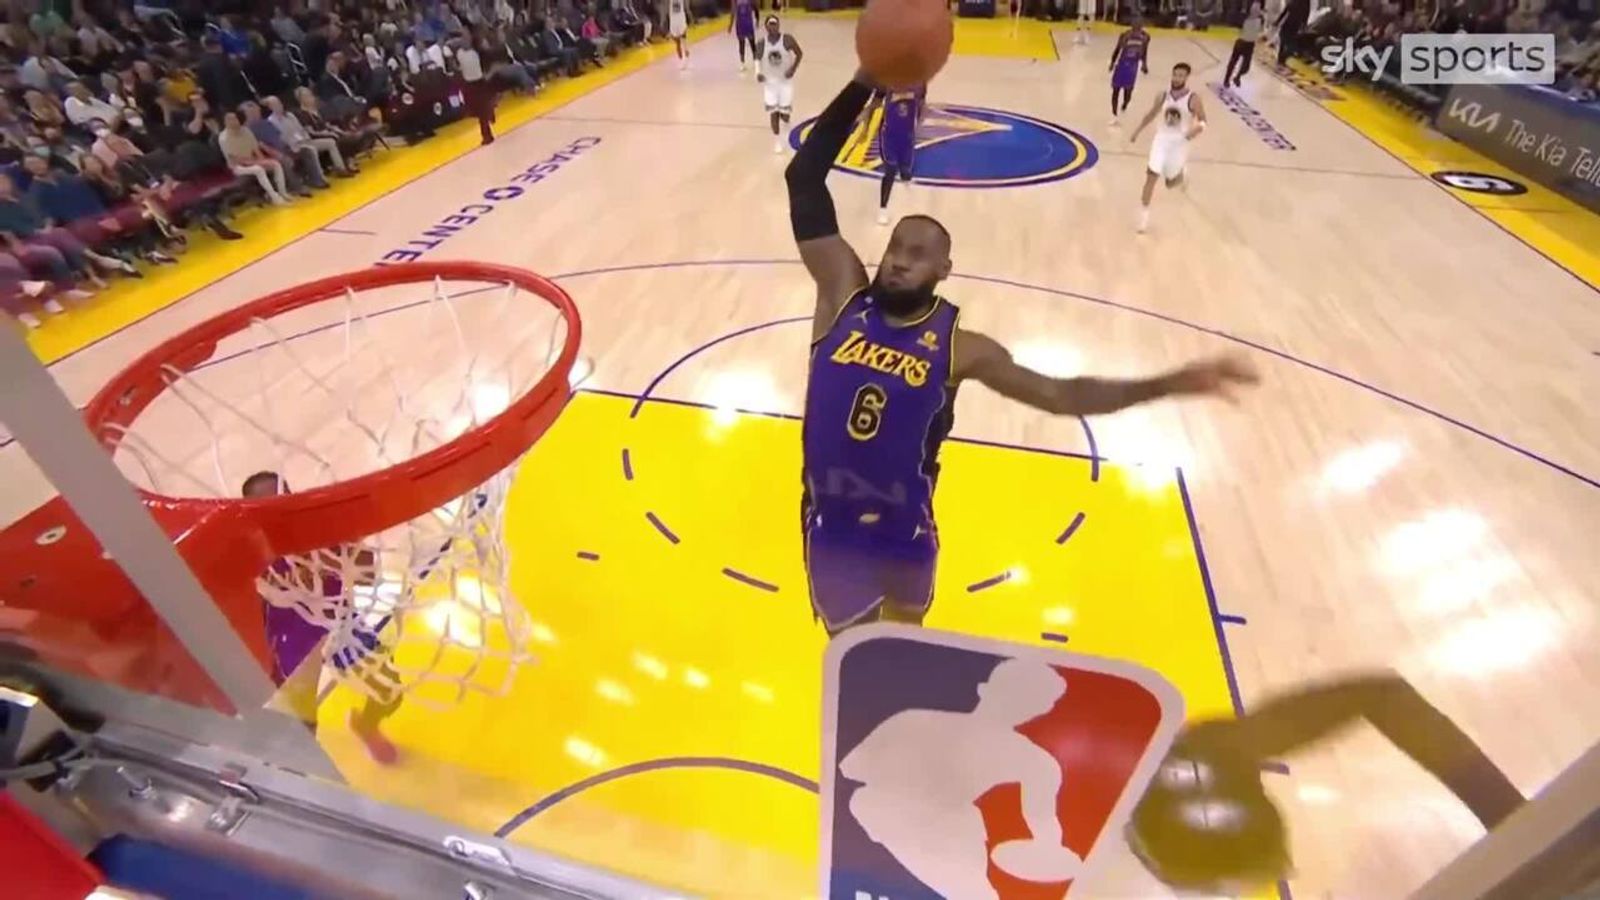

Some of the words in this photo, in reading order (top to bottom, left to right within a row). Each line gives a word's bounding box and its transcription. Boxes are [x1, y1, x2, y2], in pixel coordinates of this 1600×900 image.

[511, 136, 602, 184] CHASE
[1504, 118, 1536, 152] The
[1534, 133, 1567, 167] Kia
[374, 203, 494, 267] CENTE
[831, 330, 932, 387] LAKERS
[846, 382, 888, 442] 6
